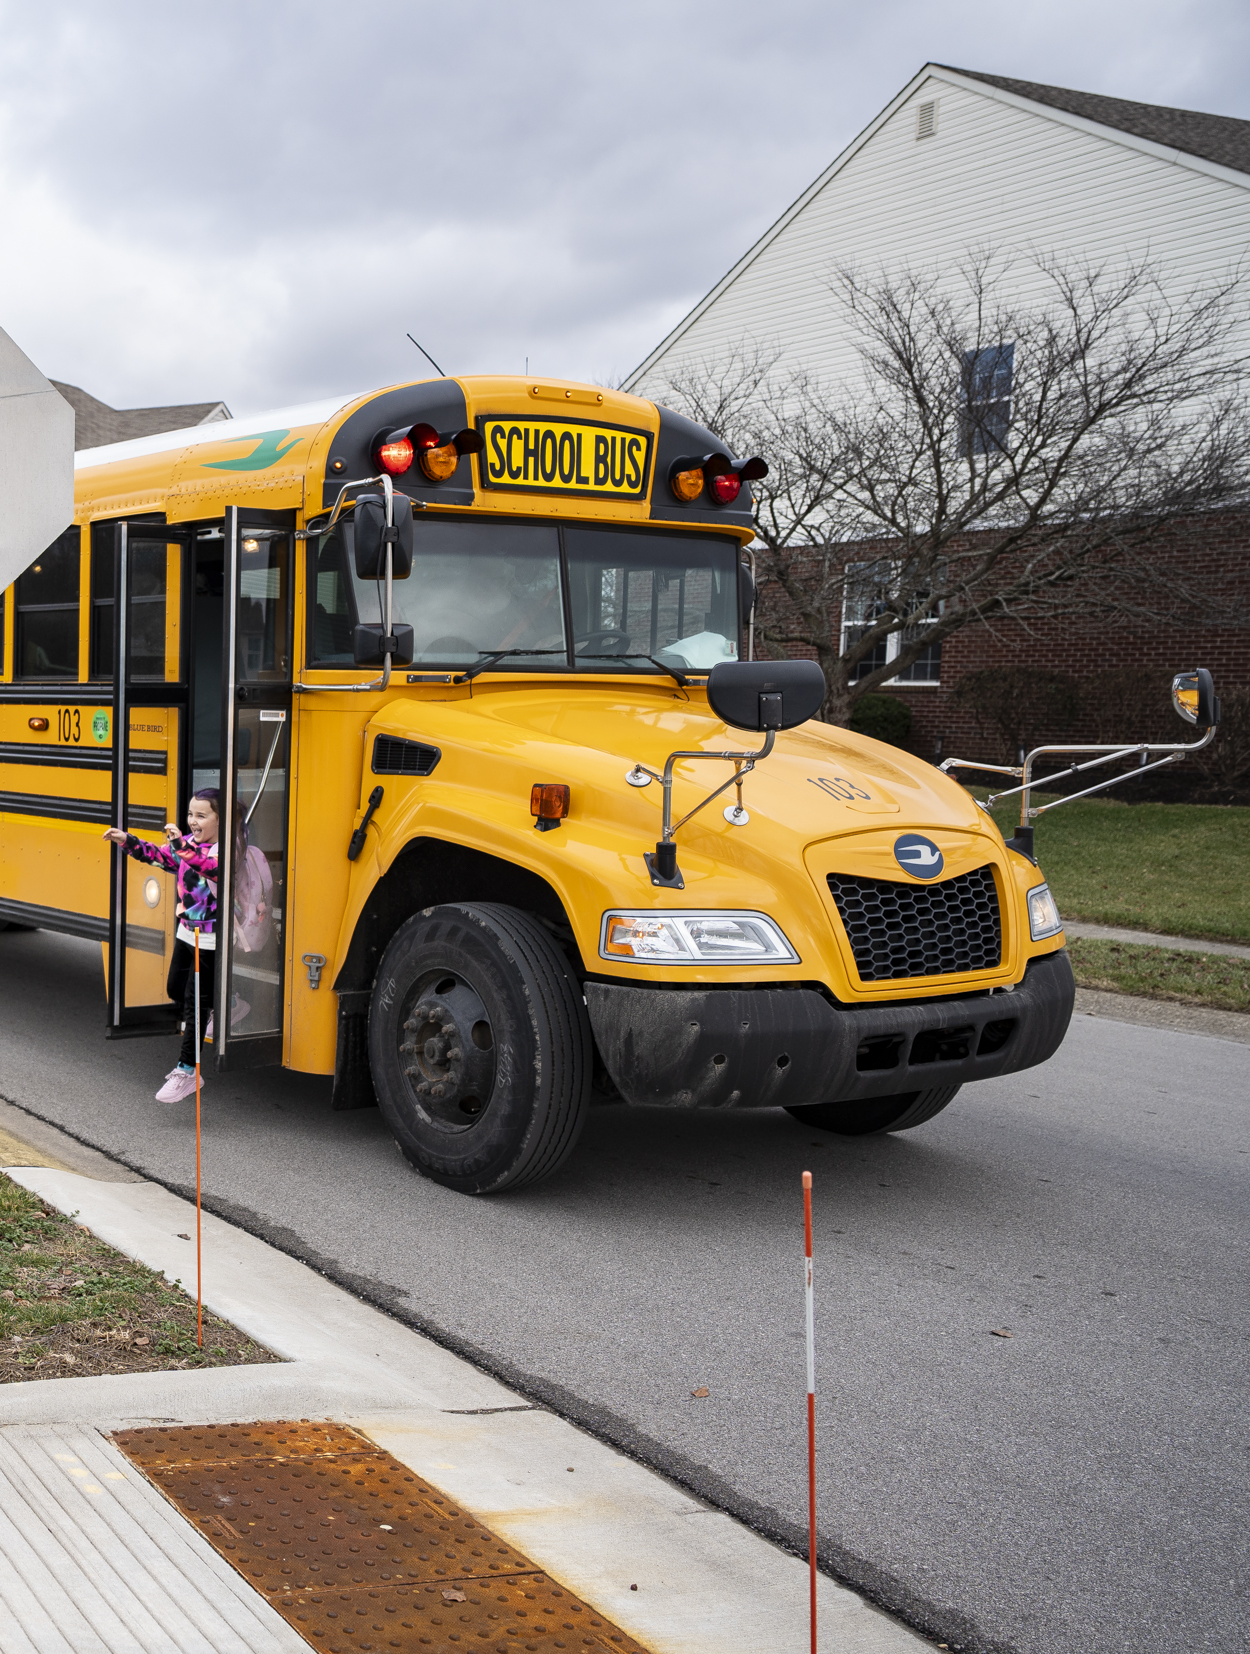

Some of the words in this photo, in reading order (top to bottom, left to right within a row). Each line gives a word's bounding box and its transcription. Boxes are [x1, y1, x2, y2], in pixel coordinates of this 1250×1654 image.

[489, 424, 590, 485] SCHOOL
[593, 434, 642, 489] BUS
[57, 708, 81, 743] 103
[129, 723, 146, 732] BLUE
[146, 724, 163, 732] BIRD
[806, 777, 871, 801] 103
